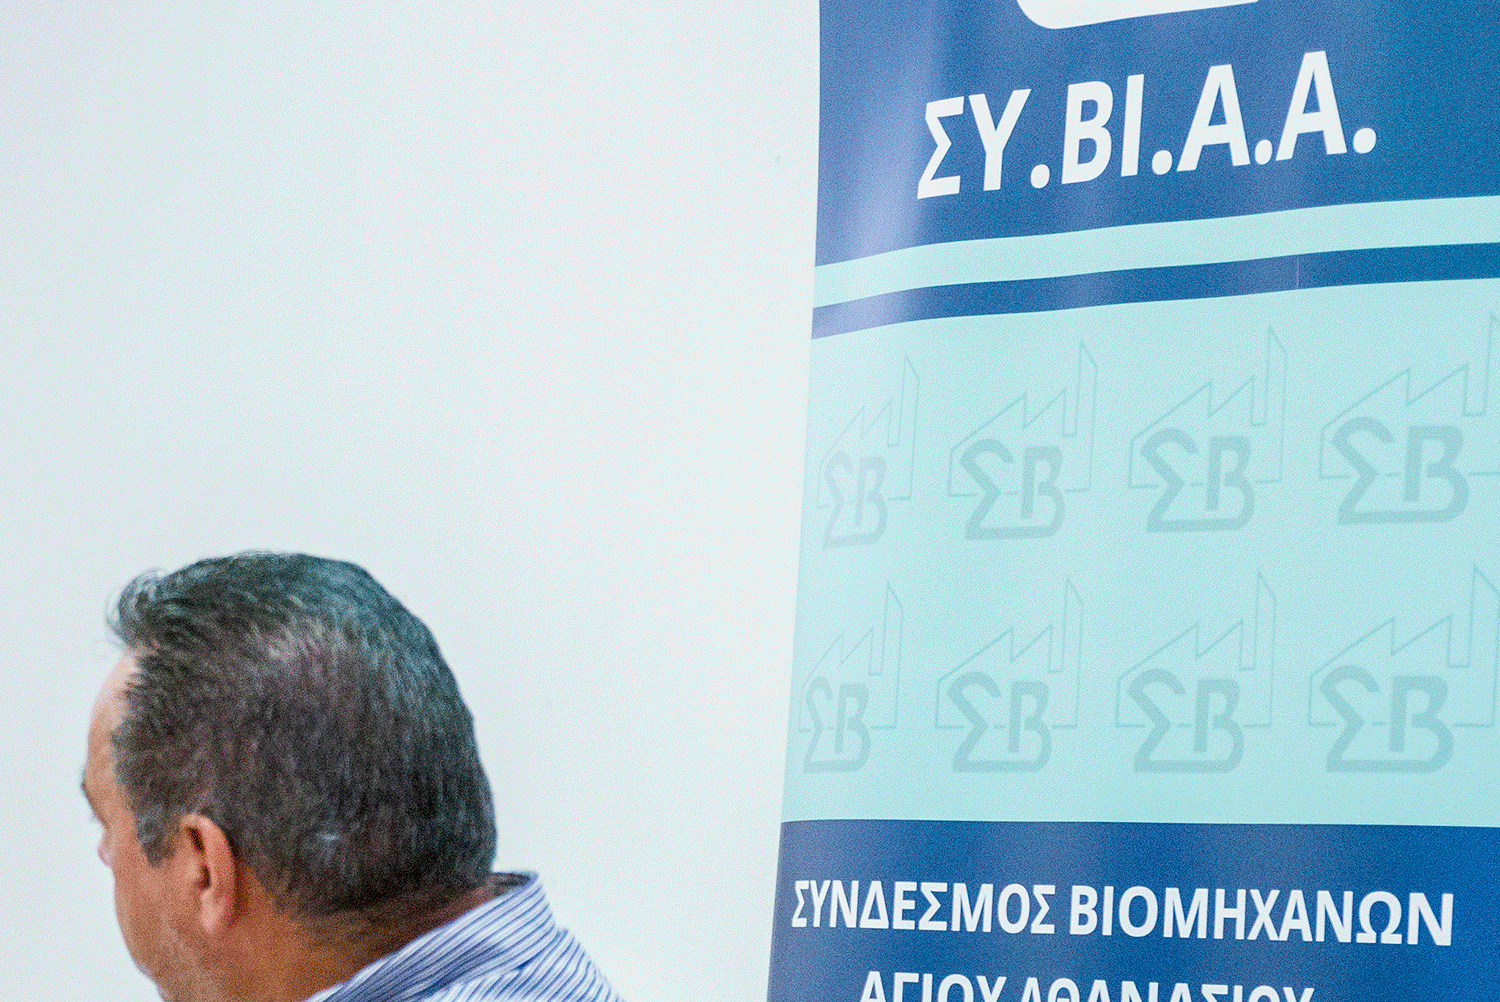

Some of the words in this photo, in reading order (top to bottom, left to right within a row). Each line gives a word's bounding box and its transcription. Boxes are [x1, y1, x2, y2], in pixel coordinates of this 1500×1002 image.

[917, 51, 1377, 200] ΣΥ.ΒΙ.Α.Α.
[791, 880, 1055, 935] ΣΥΝΔΕΣΜΟΣ
[1069, 886, 1453, 945] ΒΙΟΜΗΧΑΝΩΝ
